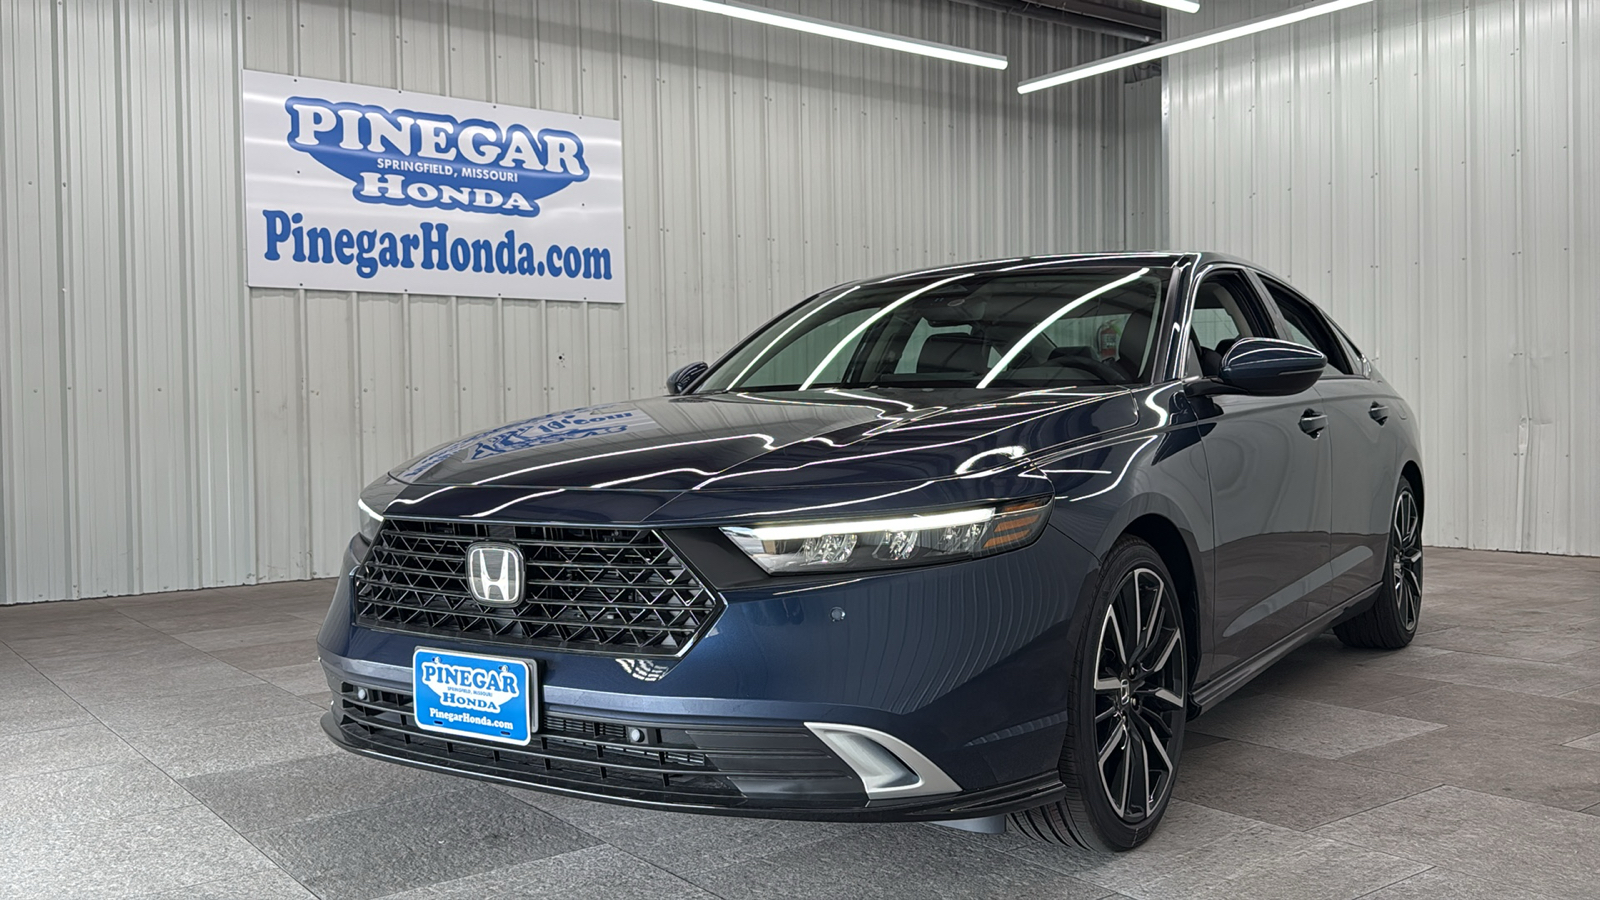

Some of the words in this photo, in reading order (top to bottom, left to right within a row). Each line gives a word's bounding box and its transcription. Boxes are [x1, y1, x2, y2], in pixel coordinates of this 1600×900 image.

[291, 103, 585, 176] PINEGAR
[377, 158, 458, 178] SPRINGFIELD,
[461, 167, 519, 183] MISSOURI
[358, 171, 535, 211] HONDA
[262, 210, 613, 280] PinegarHonda.com
[423, 665, 518, 694] PINEGAR
[442, 692, 498, 710] HONDA
[429, 707, 514, 730] PinegarHonda.com
